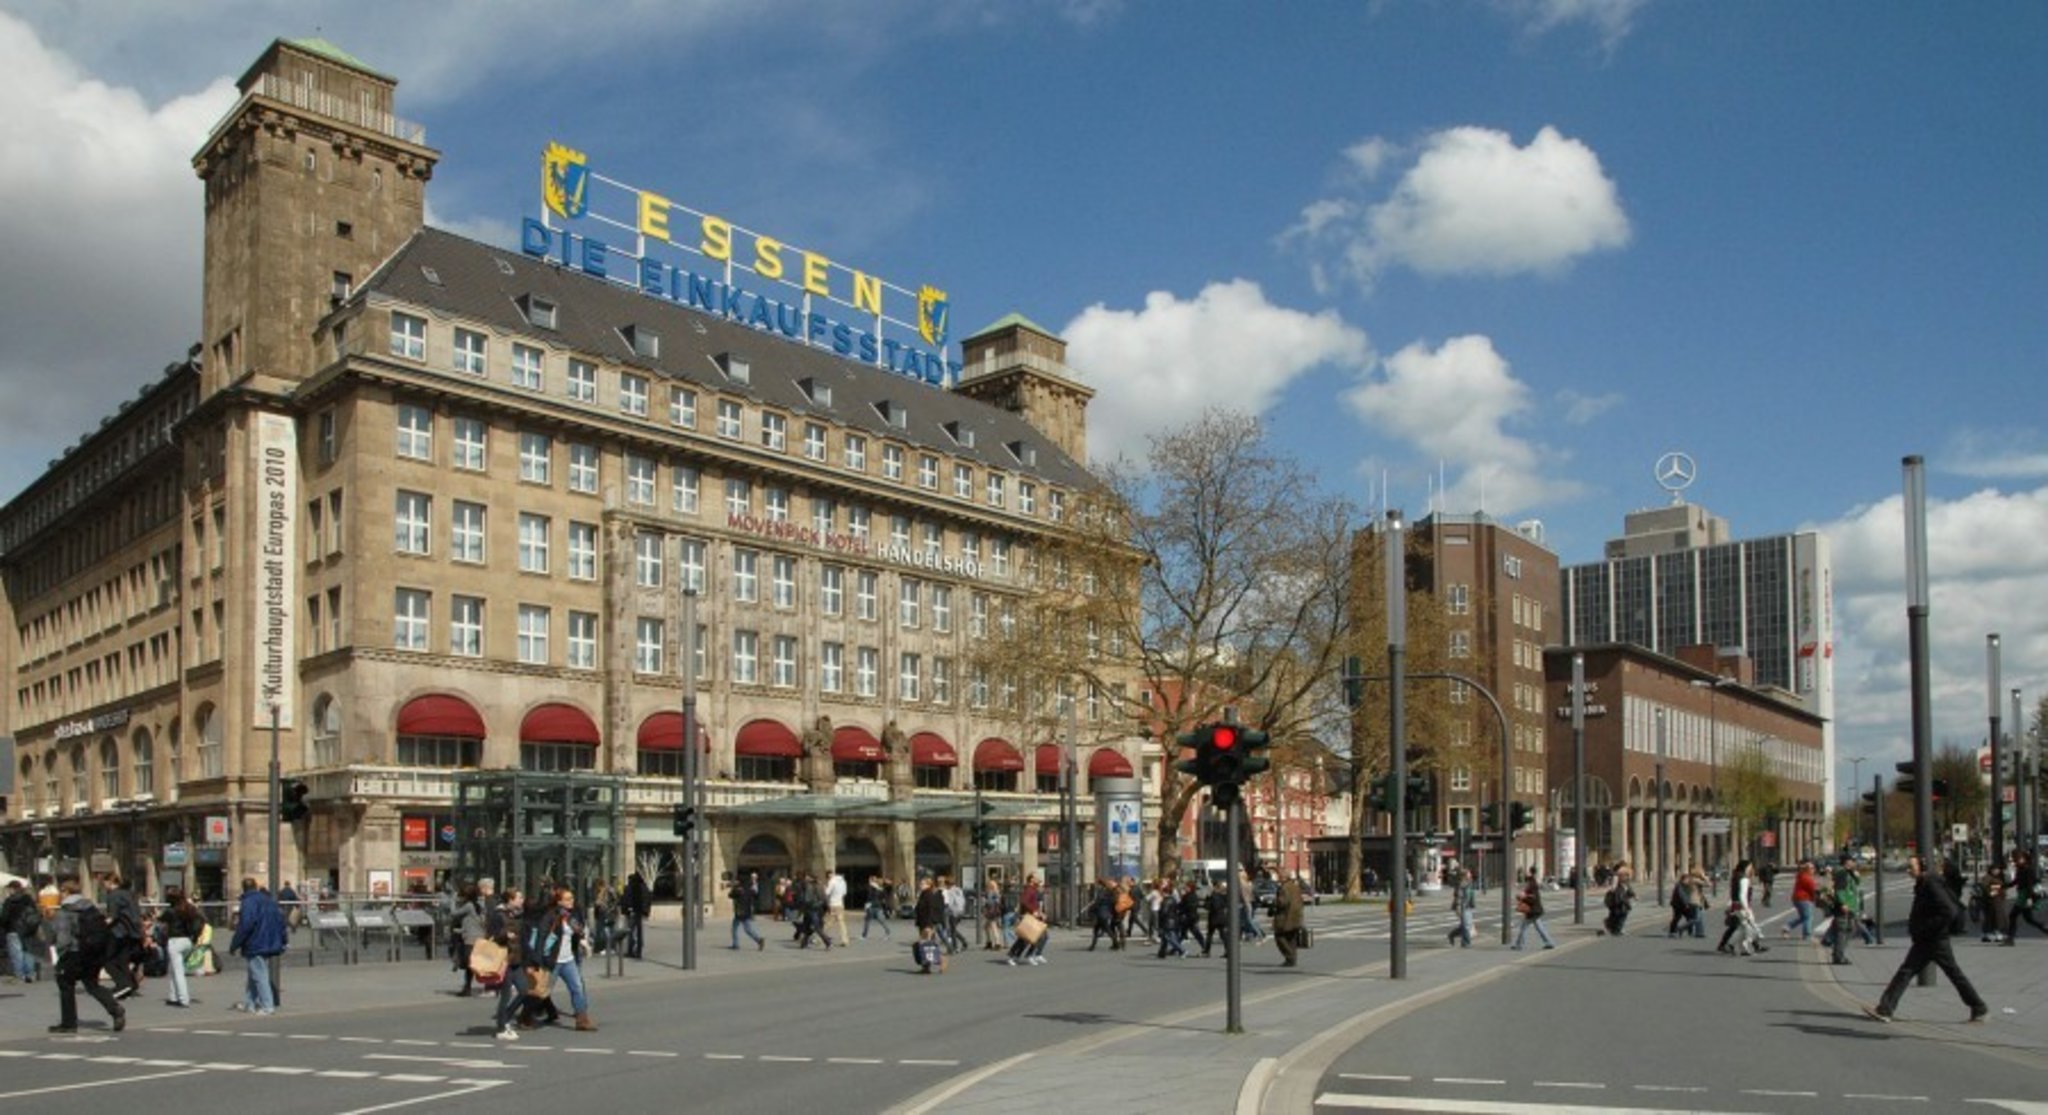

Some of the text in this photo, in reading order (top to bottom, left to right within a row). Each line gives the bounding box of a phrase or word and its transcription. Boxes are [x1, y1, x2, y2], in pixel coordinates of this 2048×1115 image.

[522, 217, 962, 385] DIE EINKAUFSSTADT
[639, 190, 881, 316] ESSEN
[262, 447, 288, 696] Kulturhauptstadt Europas 2010
[825, 530, 869, 556] HOTEL
[876, 541, 985, 578] HANDELSHOF
[1567, 682, 1599, 692] HUS
